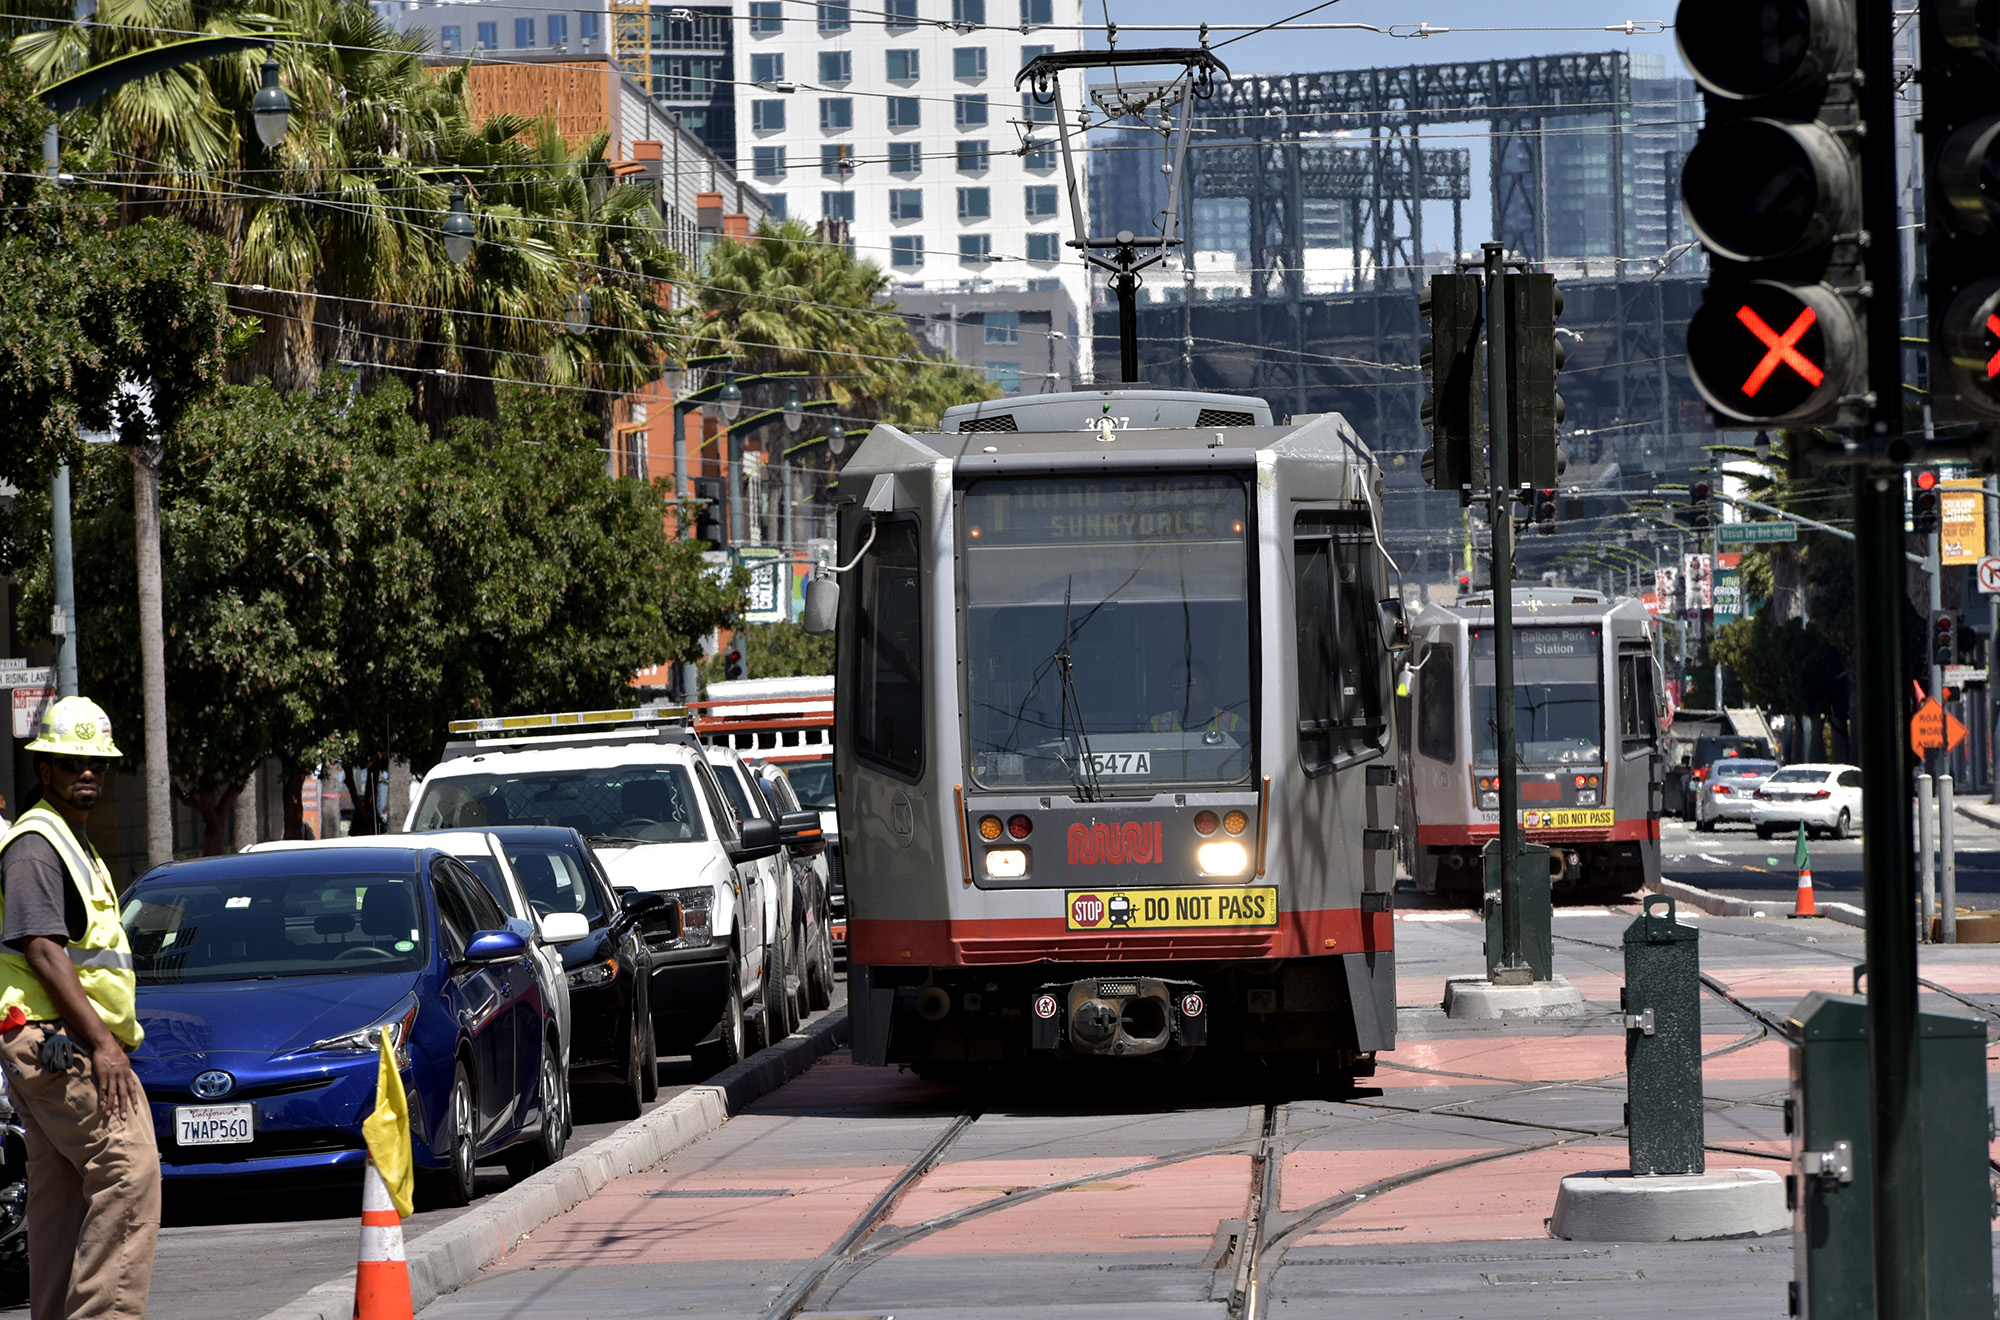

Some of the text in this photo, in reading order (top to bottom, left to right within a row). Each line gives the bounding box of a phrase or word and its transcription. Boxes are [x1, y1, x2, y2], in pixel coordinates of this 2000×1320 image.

[1013, 481, 1225, 509] THIRD STREET
[985, 493, 1011, 532] T
[1051, 511, 1208, 538] SUNNYDALE
[1521, 631, 1586, 643] Balboa Park
[1534, 643, 1574, 655] Station
[5, 672, 28, 685] RISING
[31, 671, 51, 683] LANE
[15, 697, 26, 708] NO
[1557, 814, 1569, 825] DO
[1571, 813, 1588, 824] NOT
[1590, 812, 1611, 823] PASS
[1075, 894, 1266, 922] STOP DO NOT PASS
[192, 1108, 238, 1119] California
[181, 1119, 248, 1140] 7WAP560
